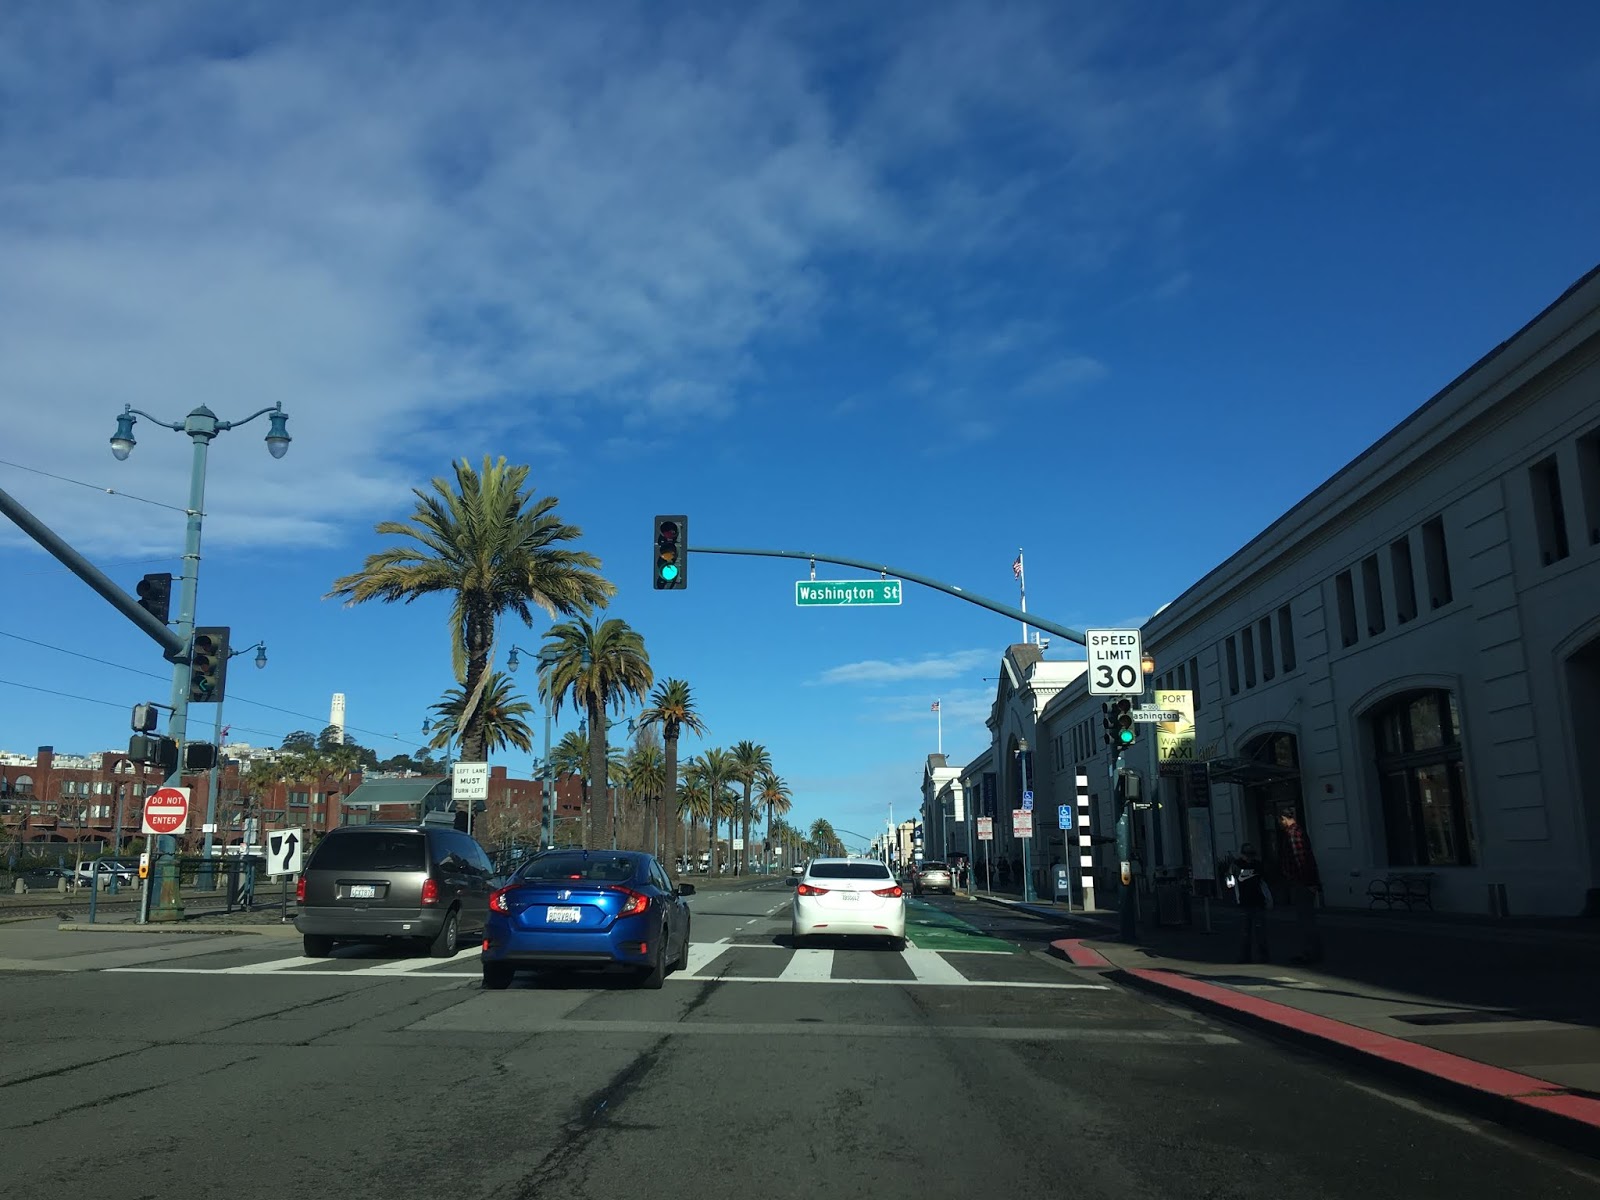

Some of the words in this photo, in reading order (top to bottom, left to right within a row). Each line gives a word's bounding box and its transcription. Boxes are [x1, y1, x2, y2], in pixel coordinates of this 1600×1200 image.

[800, 586, 874, 603] Washington
[883, 586, 898, 599] St
[1092, 635, 1136, 646] SPEED
[1097, 650, 1132, 660] LIMIT
[1096, 664, 1137, 688] 30
[1162, 694, 1186, 703] PORT
[1133, 712, 1178, 721] ashington
[1161, 737, 1192, 746] WATER
[1161, 747, 1192, 759] TAXI
[152, 816, 177, 824] ENTER
